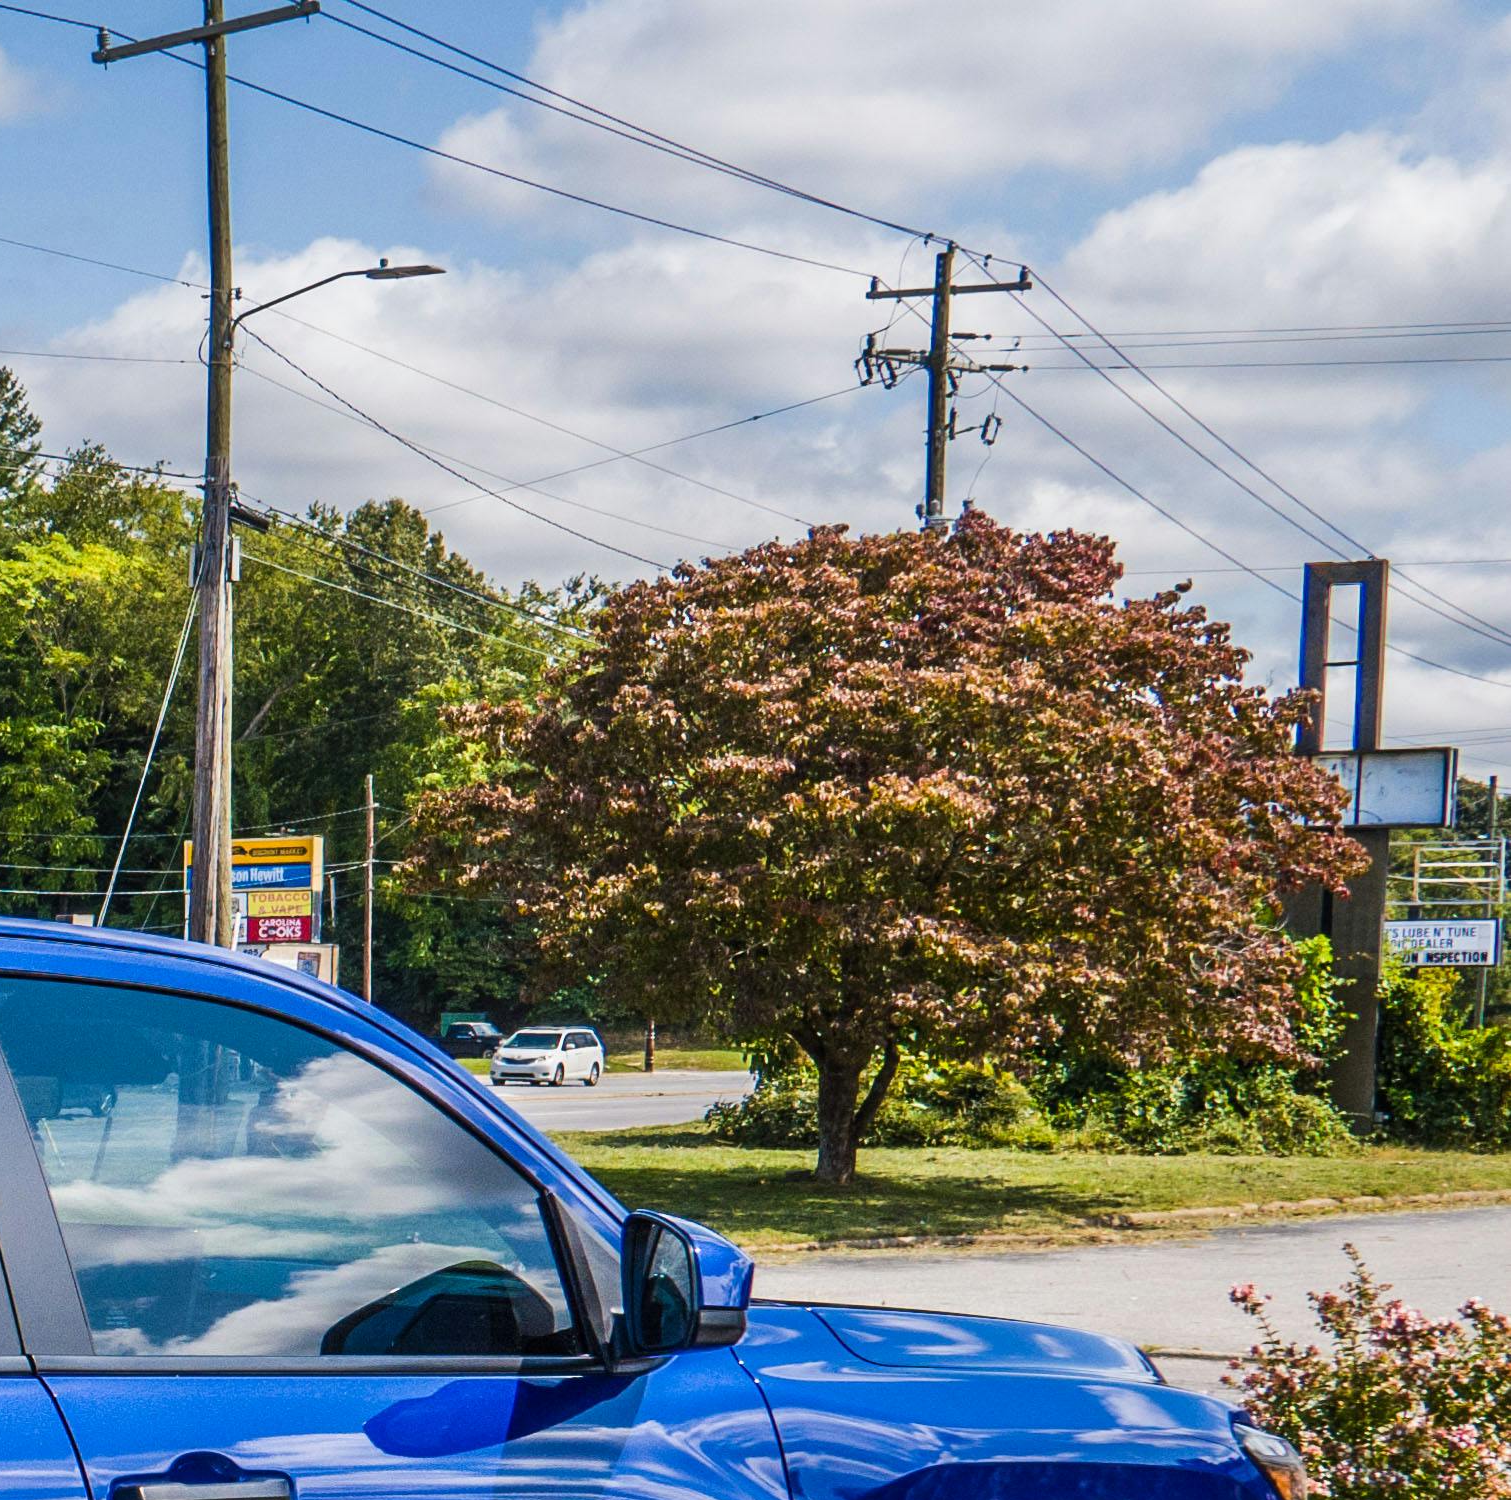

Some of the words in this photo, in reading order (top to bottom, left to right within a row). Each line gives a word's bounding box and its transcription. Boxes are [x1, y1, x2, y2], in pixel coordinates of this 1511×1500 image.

[232, 870, 249, 882] son
[250, 867, 285, 882] Hewitt
[251, 892, 310, 902] TOBACCO
[271, 905, 303, 914] VAPE
[258, 918, 302, 927] CAROLINA
[1402, 928, 1431, 938] LUBE
[1447, 927, 1477, 937] TUNE
[1411, 939, 1453, 949] DEALER
